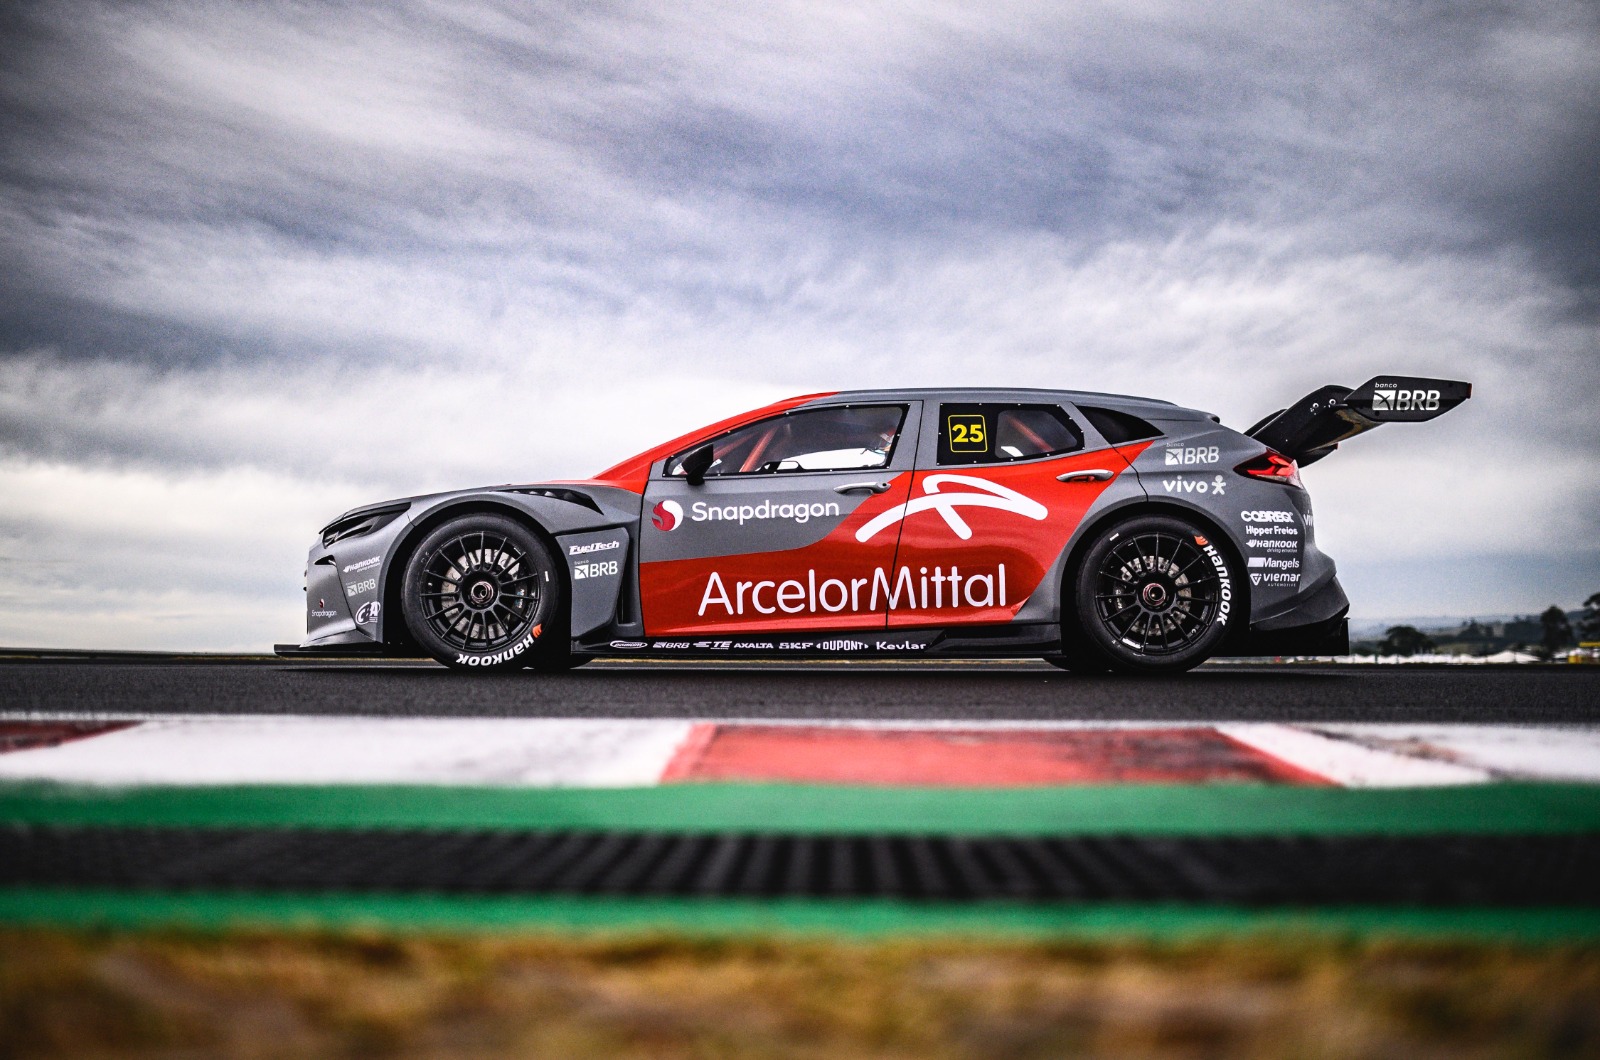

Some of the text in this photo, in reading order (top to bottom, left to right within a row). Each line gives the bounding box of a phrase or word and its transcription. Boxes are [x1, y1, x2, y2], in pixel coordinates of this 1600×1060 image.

[1396, 390, 1441, 411] BRB
[952, 424, 984, 443] 25
[1184, 446, 1219, 464] BRB
[1162, 475, 1208, 493] vivo
[691, 498, 840, 525] Snapdragon
[1273, 525, 1298, 535] Freios
[569, 540, 620, 556] FuelTech
[590, 560, 618, 578] BRB
[1263, 557, 1300, 570] Mangels
[357, 578, 376, 594] BRB
[698, 563, 1006, 616] ArcelorMittal
[779, 642, 814, 650] SKF
[822, 640, 927, 651] DUPONT Kevlar
